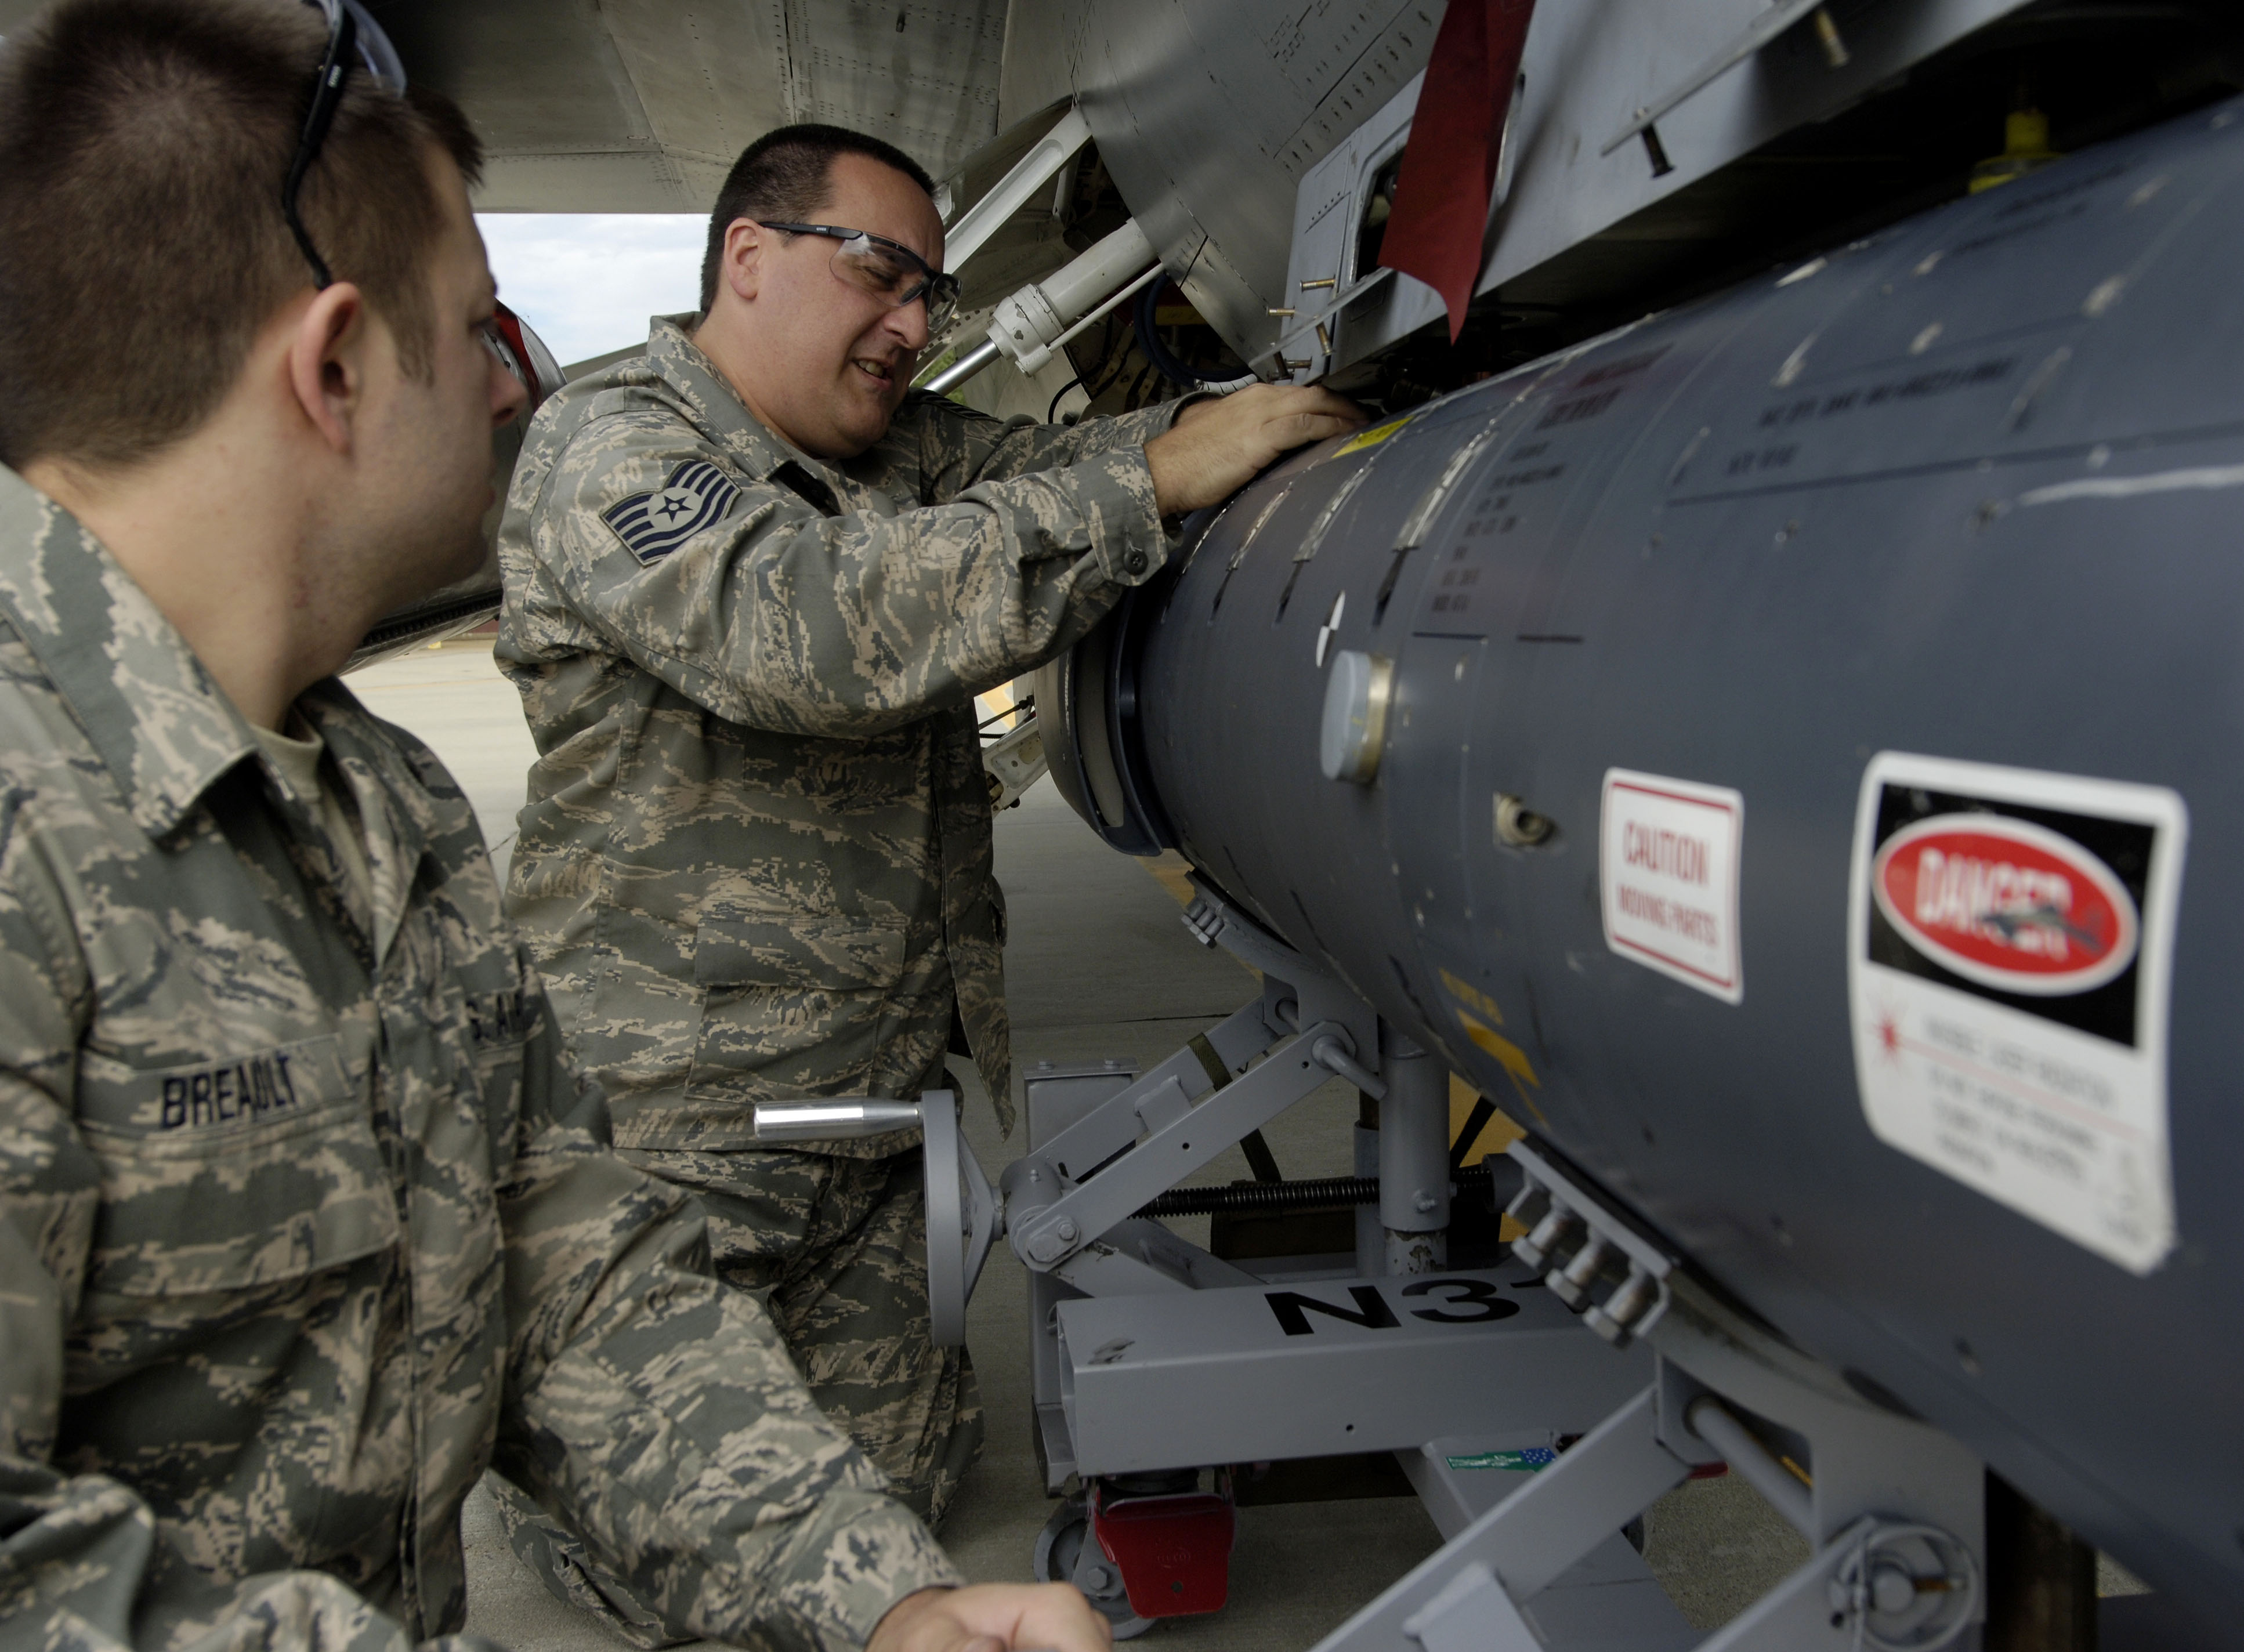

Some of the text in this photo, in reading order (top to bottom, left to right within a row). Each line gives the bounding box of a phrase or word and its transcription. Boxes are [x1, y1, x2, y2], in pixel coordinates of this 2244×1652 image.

[1623, 819, 1711, 887] CAUTION
[1916, 847, 2073, 963] DANGER
[162, 1056, 296, 1129] BREAULT
